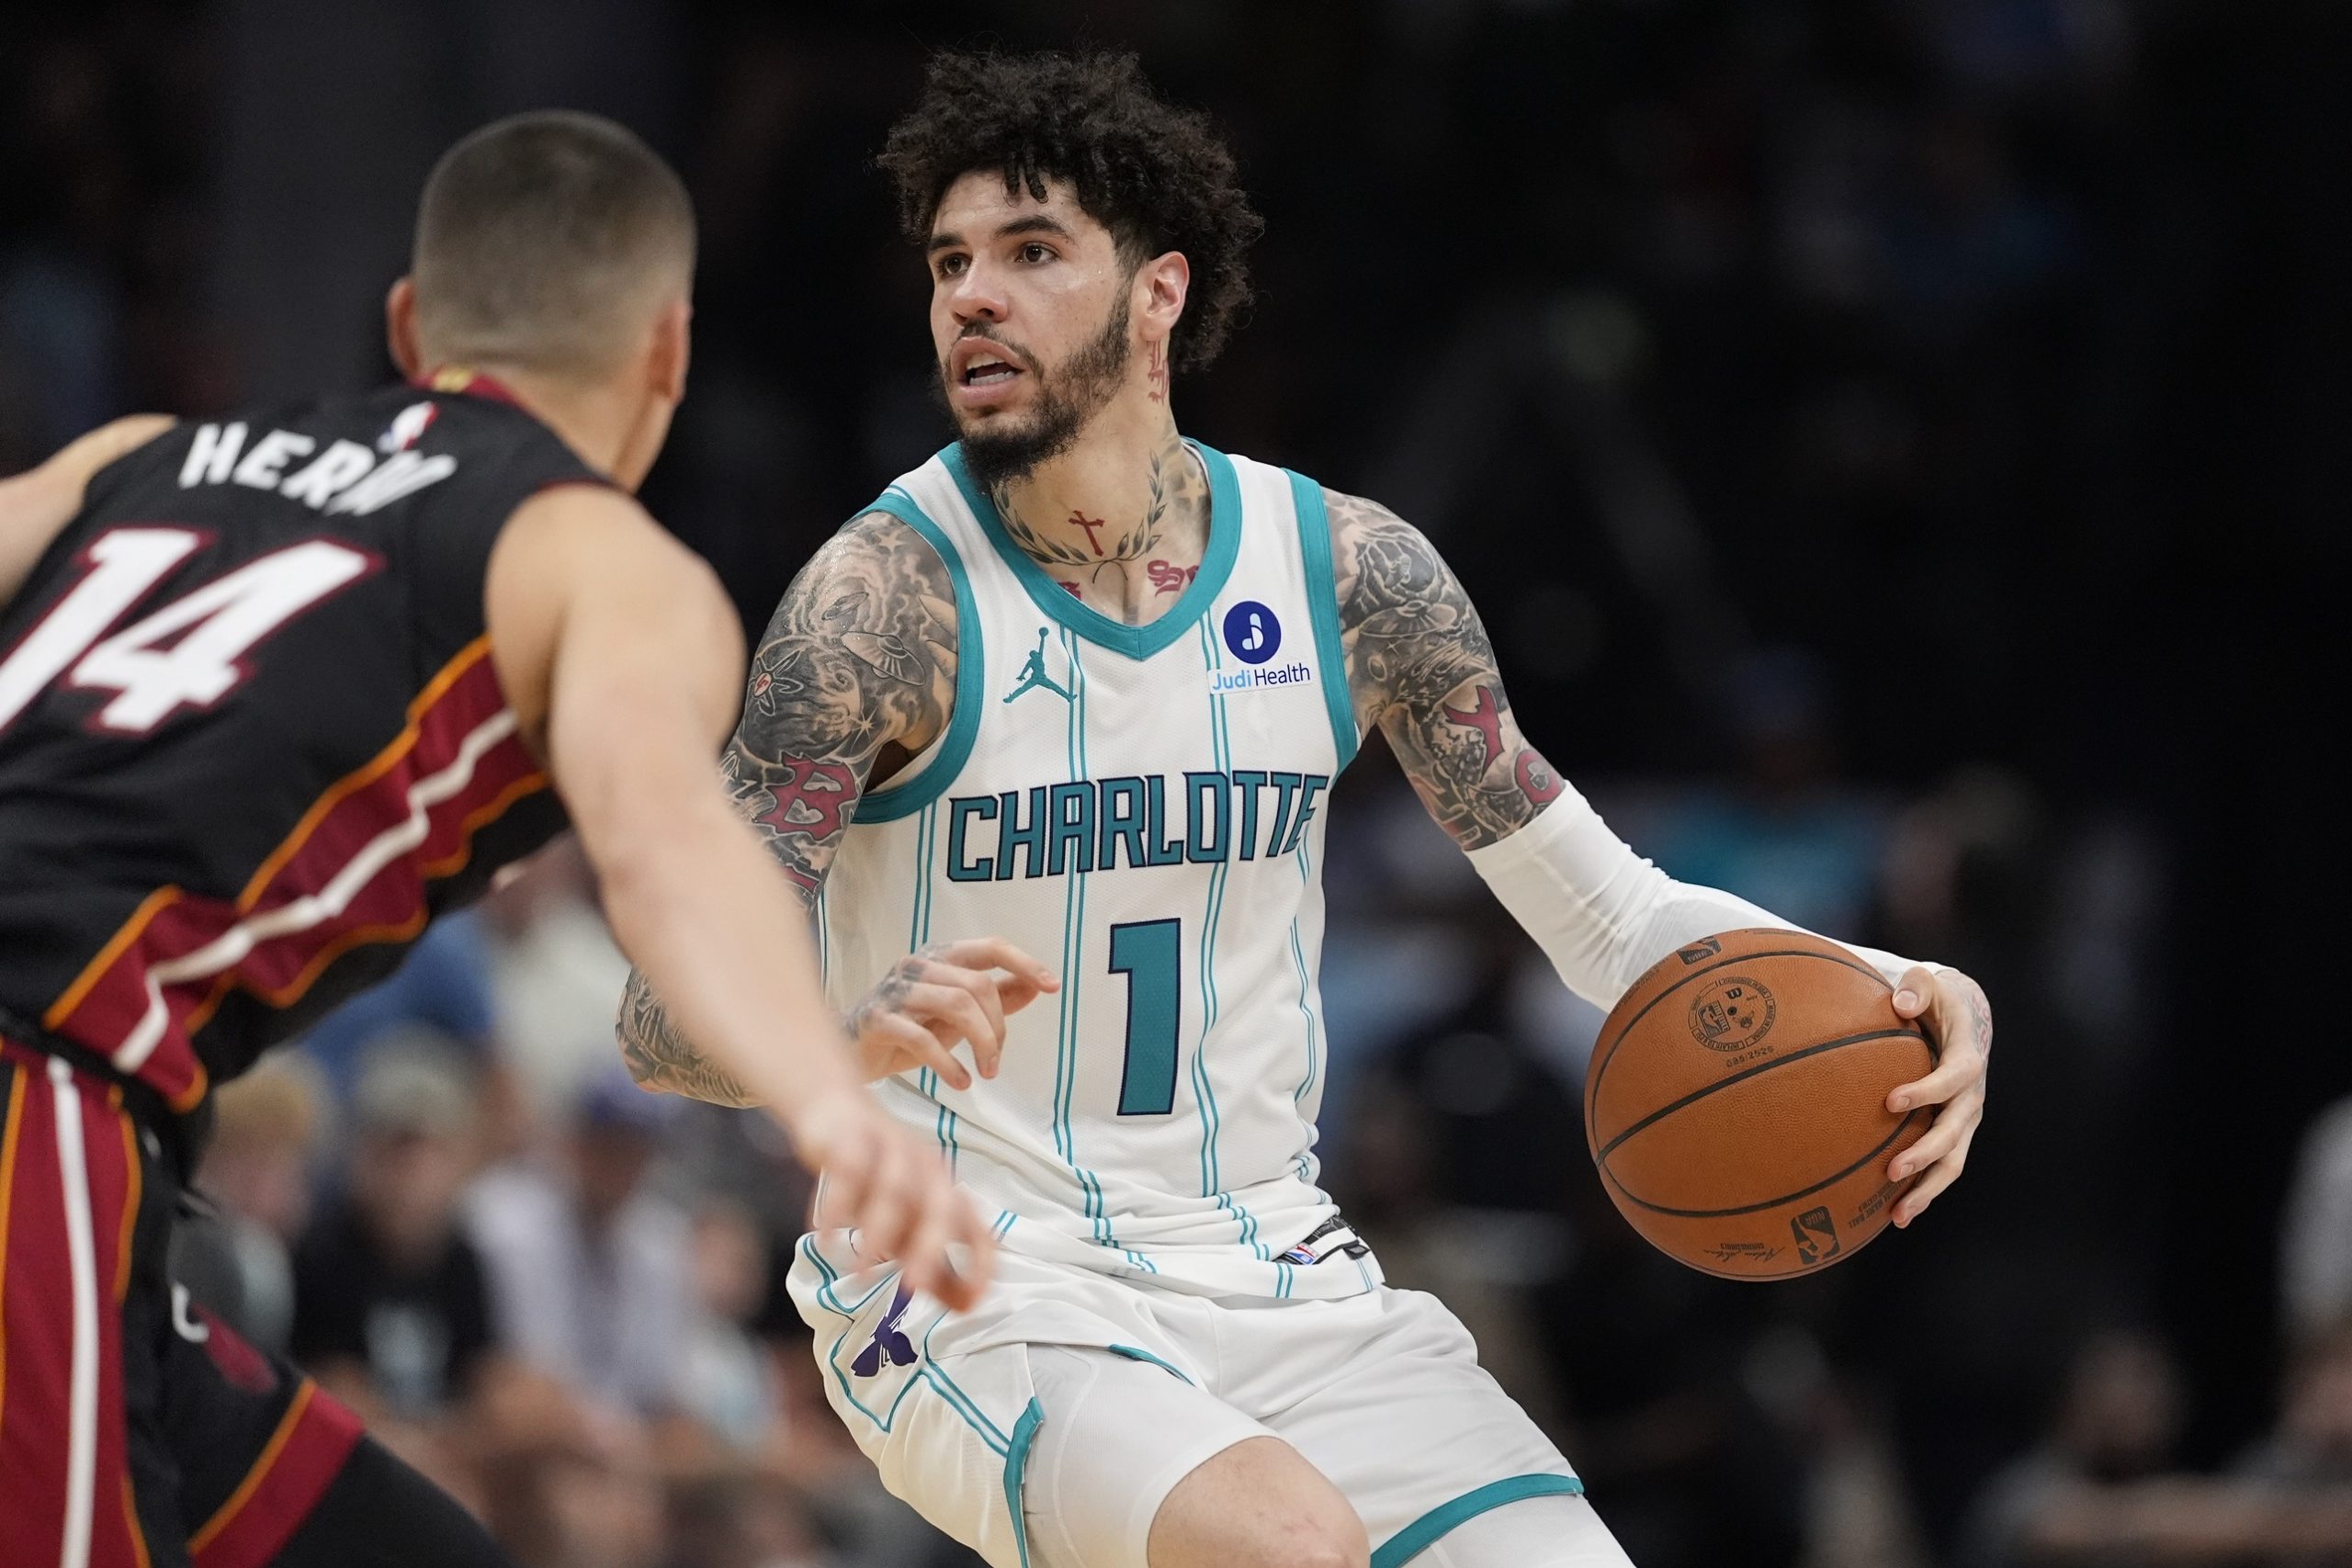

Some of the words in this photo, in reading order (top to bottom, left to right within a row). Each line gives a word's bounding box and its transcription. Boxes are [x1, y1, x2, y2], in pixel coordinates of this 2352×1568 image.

[0, 525, 384, 739] 14
[1213, 669, 1251, 690] Judi
[1254, 662, 1311, 686] Health
[946, 769, 1329, 883] CHARLOTTE
[1107, 917, 1182, 1116] 1
